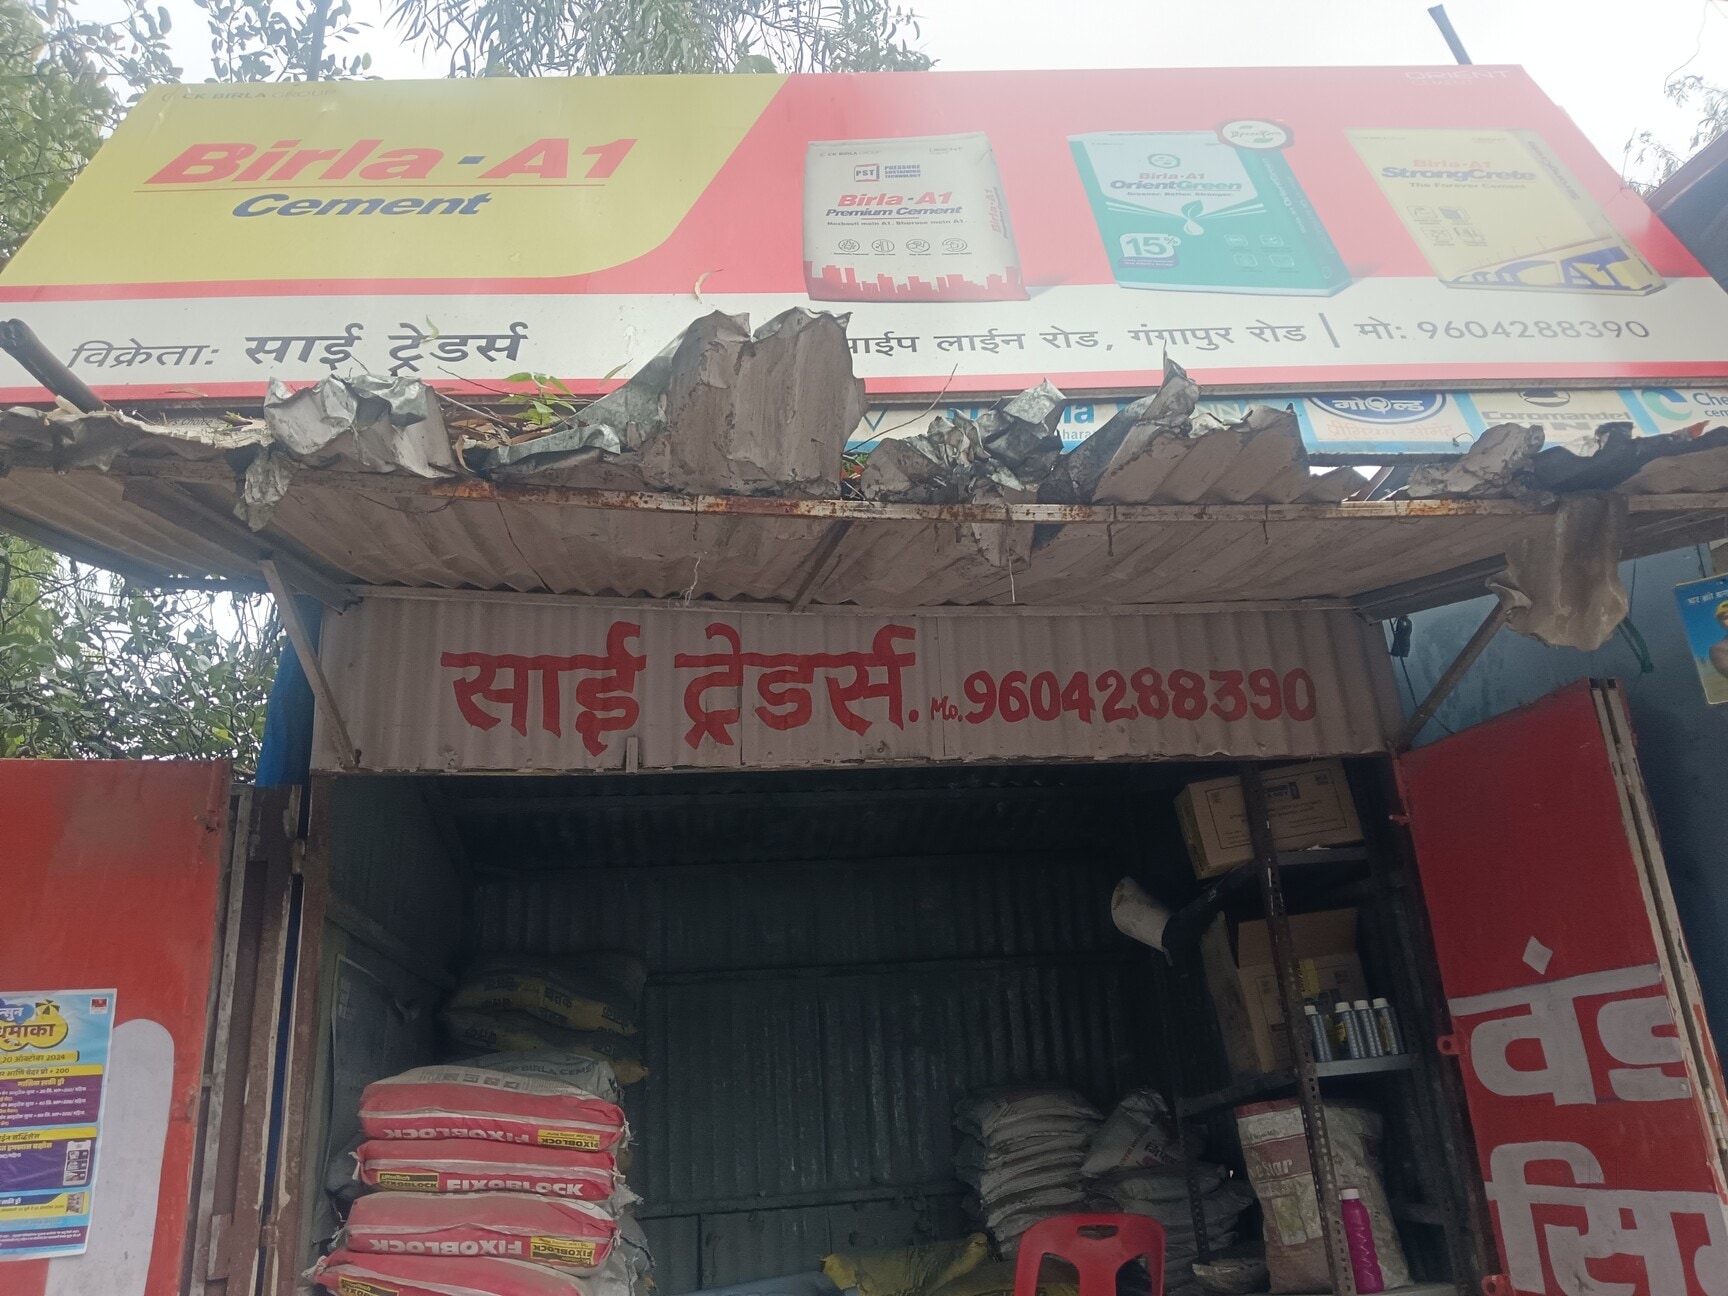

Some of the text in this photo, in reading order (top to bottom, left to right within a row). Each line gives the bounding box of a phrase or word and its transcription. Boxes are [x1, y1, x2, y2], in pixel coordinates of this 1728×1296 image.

[212, 91, 266, 100] BIRLA
[855, 169, 875, 178] PST
[1381, 167, 1537, 182] StrongCrete
[1110, 180, 1243, 191] OrientGreen
[231, 191, 493, 218] Cement
[825, 206, 964, 217] Premium Cement
[932, 327, 1027, 357] लाईन
[1040, 324, 1114, 352] रोड,
[1128, 320, 1235, 352] गंगापुर
[1244, 318, 1308, 344] रोड
[1416, 319, 1651, 341] 9604288390
[66, 321, 529, 375] विक्रेता: साई ट्रेडर्स
[1482, 411, 1633, 421] Coromandel
[441, 620, 647, 757] साई
[962, 667, 1318, 725] 9604288390
[46, 1053, 66, 1061] 2024
[383, 1127, 530, 1145] FIXOBLOCK
[540, 1136, 600, 1150] FIXOBLOCK
[446, 1178, 584, 1197] FIXOBLOCK
[368, 1238, 523, 1256] FIXOBLOCK
[532, 1244, 594, 1259] FIXOBLOCK
